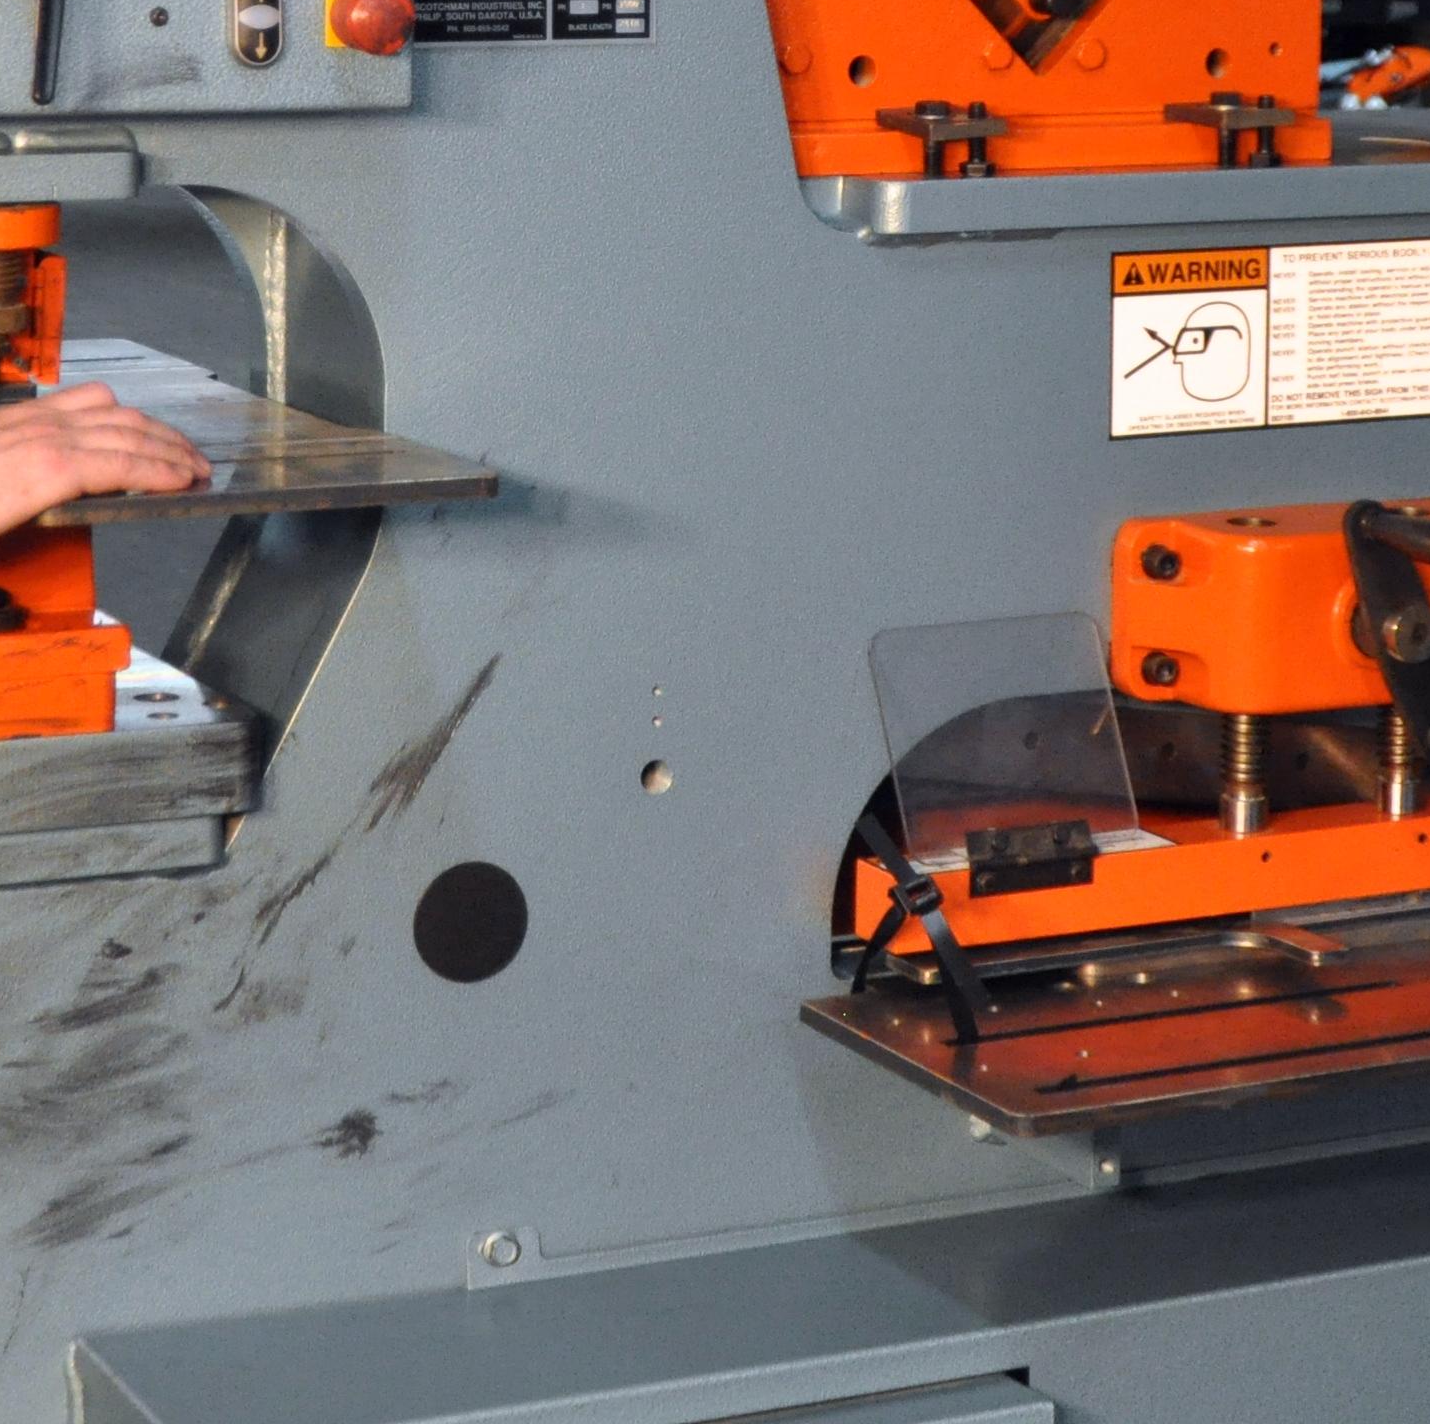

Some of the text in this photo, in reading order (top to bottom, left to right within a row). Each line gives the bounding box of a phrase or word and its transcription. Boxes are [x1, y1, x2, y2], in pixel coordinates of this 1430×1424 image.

[446, 12, 476, 20] SOUTH
[1283, 254, 1296, 263] TO
[1298, 251, 1343, 262] PREVENT
[1347, 249, 1388, 260] SERIOUS
[1148, 258, 1261, 284] WARNING
[1306, 390, 1340, 400] REMOVE
